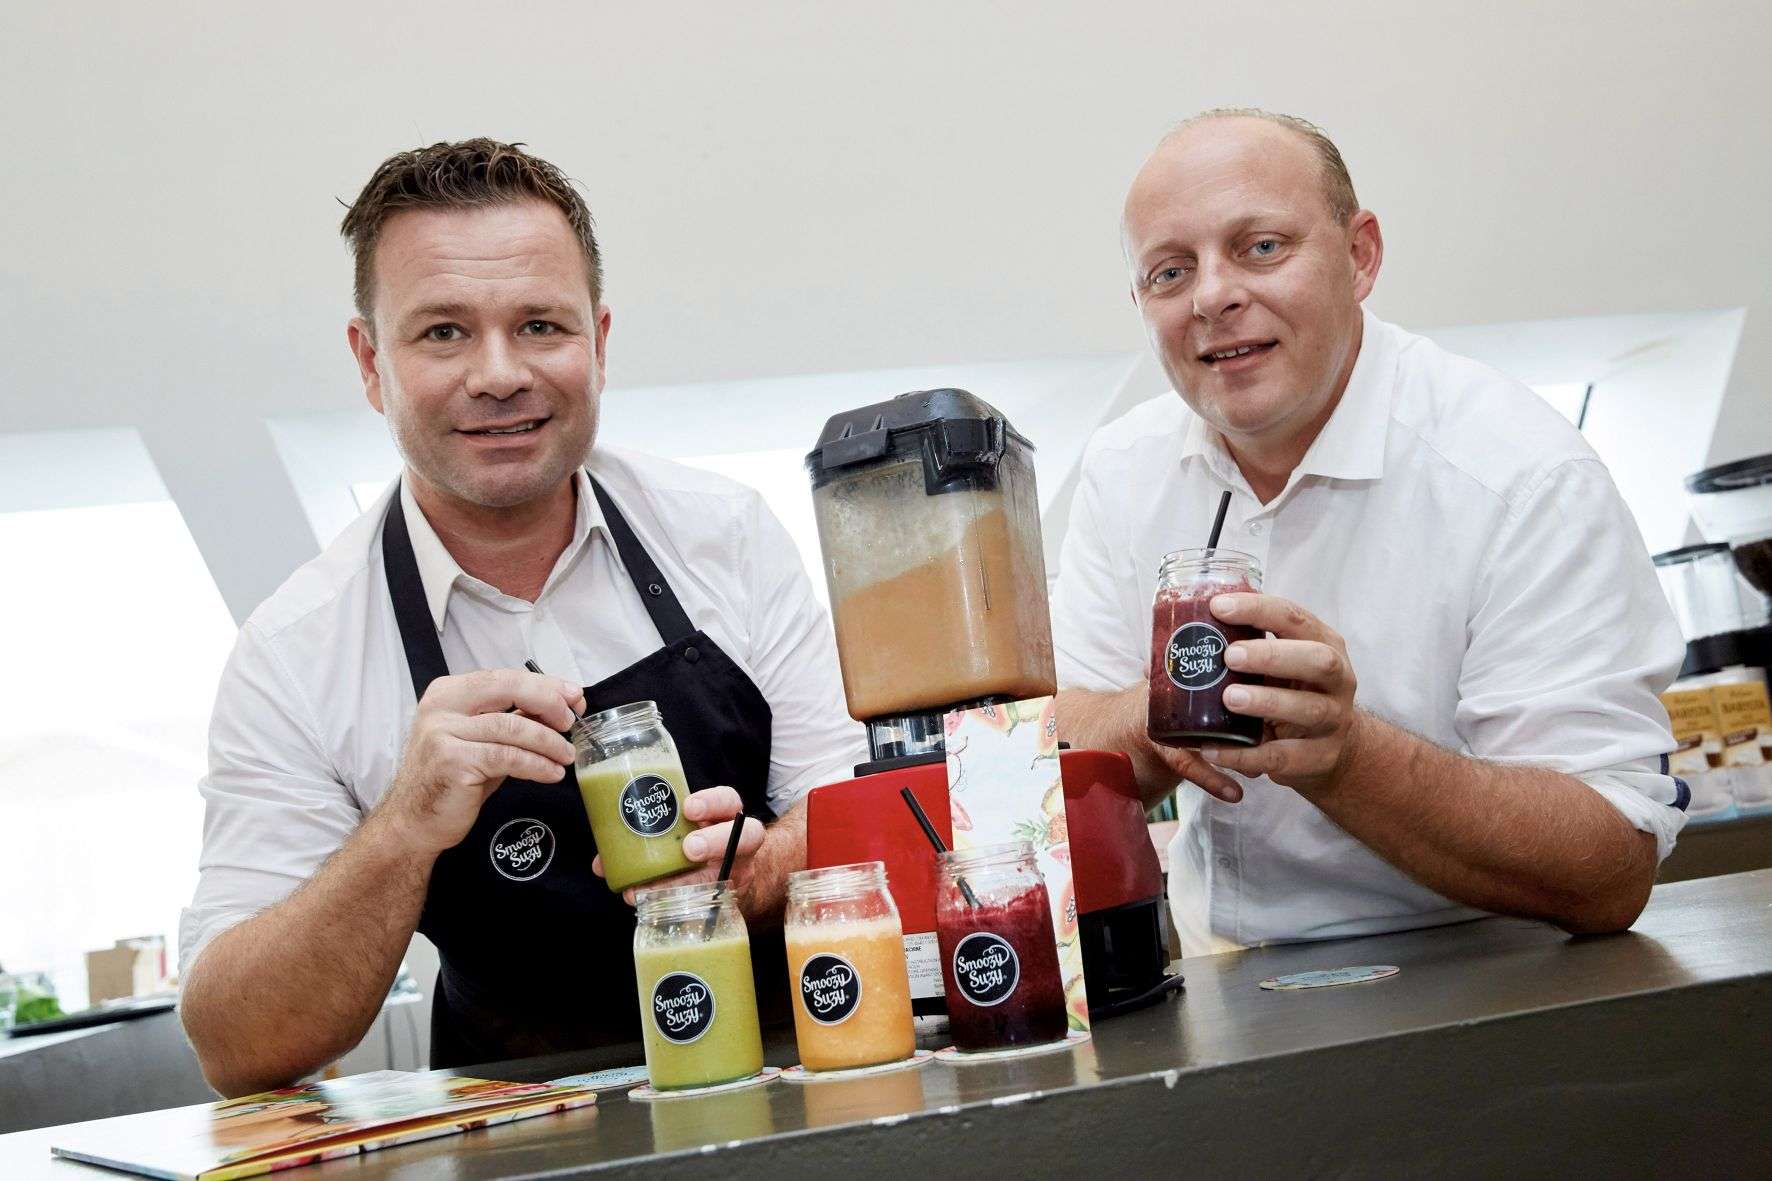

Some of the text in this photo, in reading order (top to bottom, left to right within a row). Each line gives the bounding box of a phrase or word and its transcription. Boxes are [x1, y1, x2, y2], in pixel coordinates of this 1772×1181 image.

[1170, 636, 1224, 659] Smoozy
[1179, 656, 1213, 678] Suzy
[624, 782, 671, 813] Smoozy
[638, 803, 669, 826] Suzy
[495, 825, 546, 859] Smoozy
[509, 844, 542, 871] Suzy
[957, 944, 1010, 974] Smoozy
[803, 964, 853, 993] Smoozy
[969, 968, 1003, 994] Suzy
[655, 983, 706, 1012] Smoozy
[813, 988, 846, 1013] Suzy
[666, 1007, 699, 1032] Suzy
